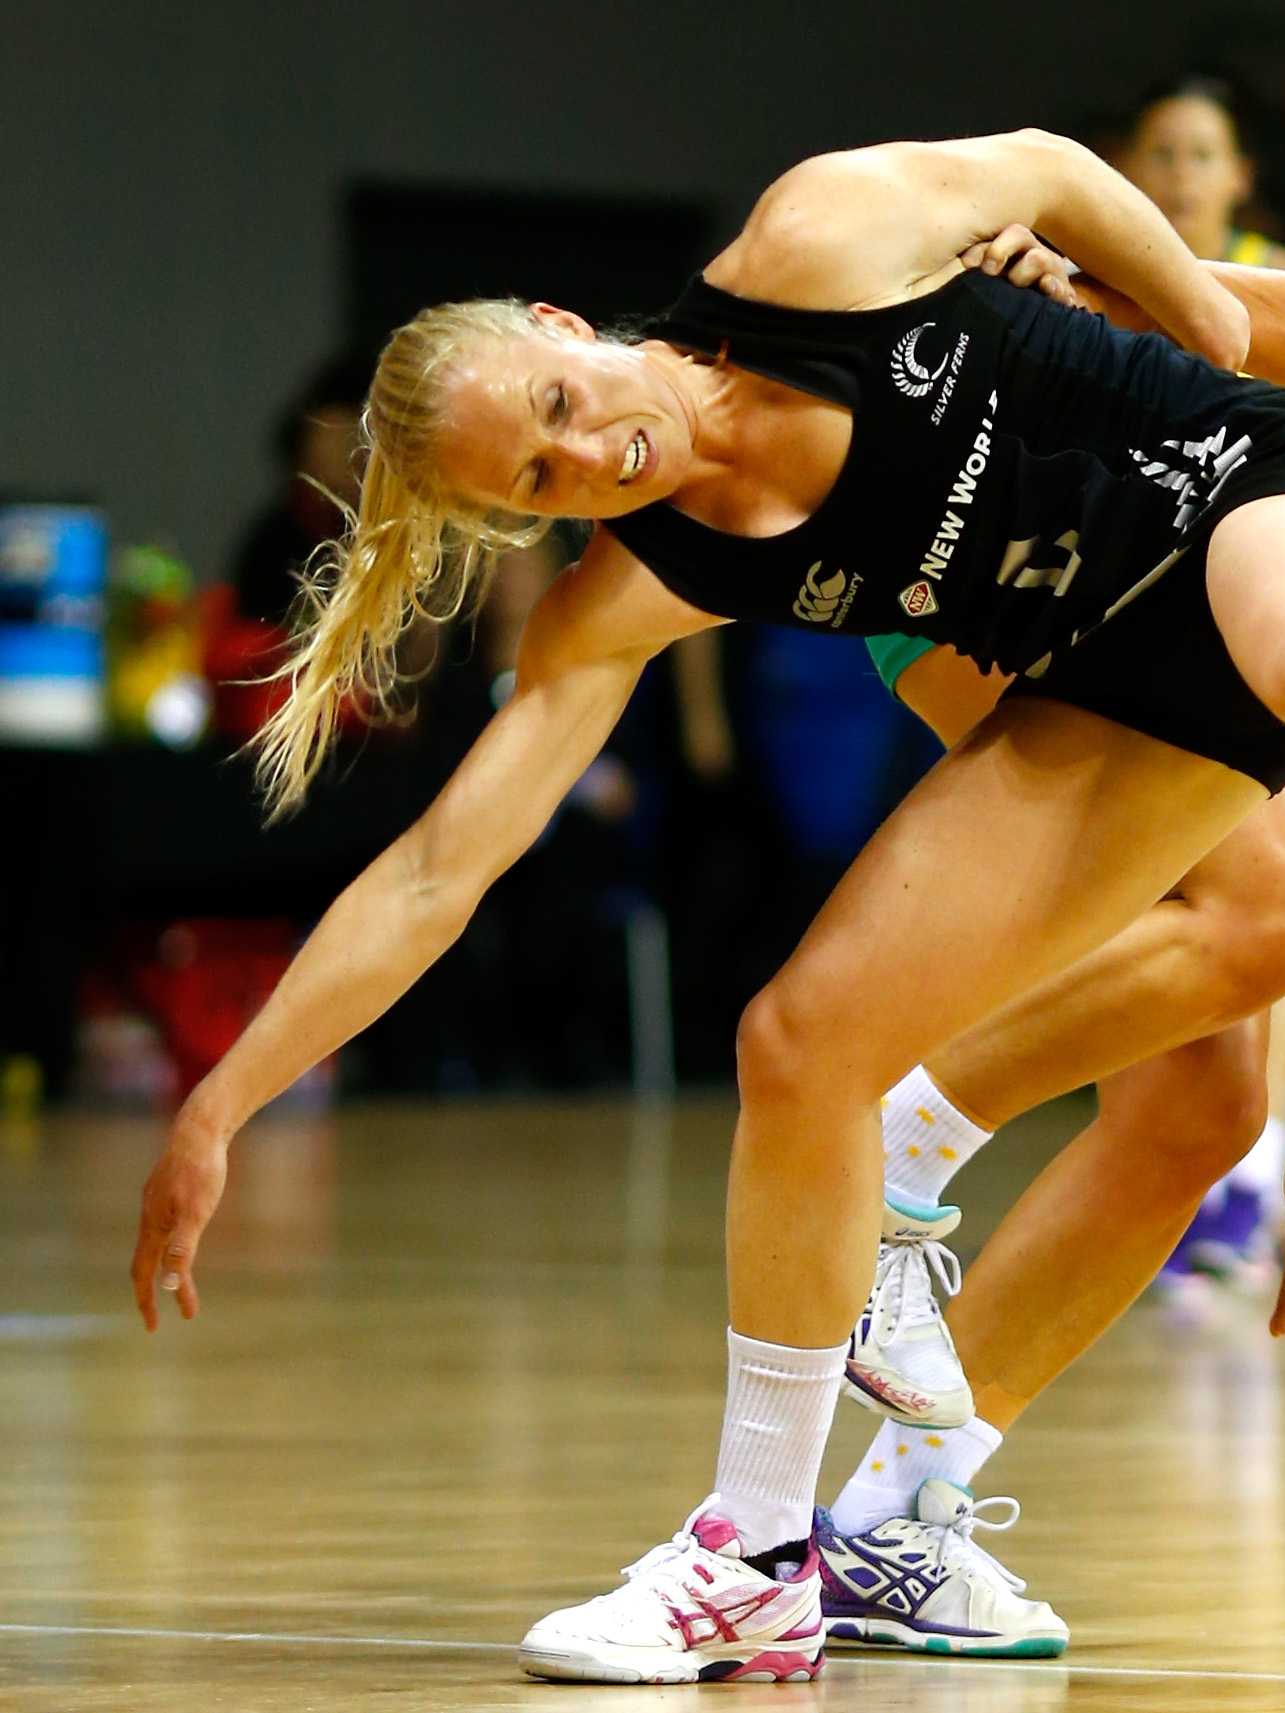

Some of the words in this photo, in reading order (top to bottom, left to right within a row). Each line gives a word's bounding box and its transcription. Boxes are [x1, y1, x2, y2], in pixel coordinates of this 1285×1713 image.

[931, 376, 957, 426] SILVER
[951, 332, 970, 375] FERNS
[919, 510, 965, 581] NEW
